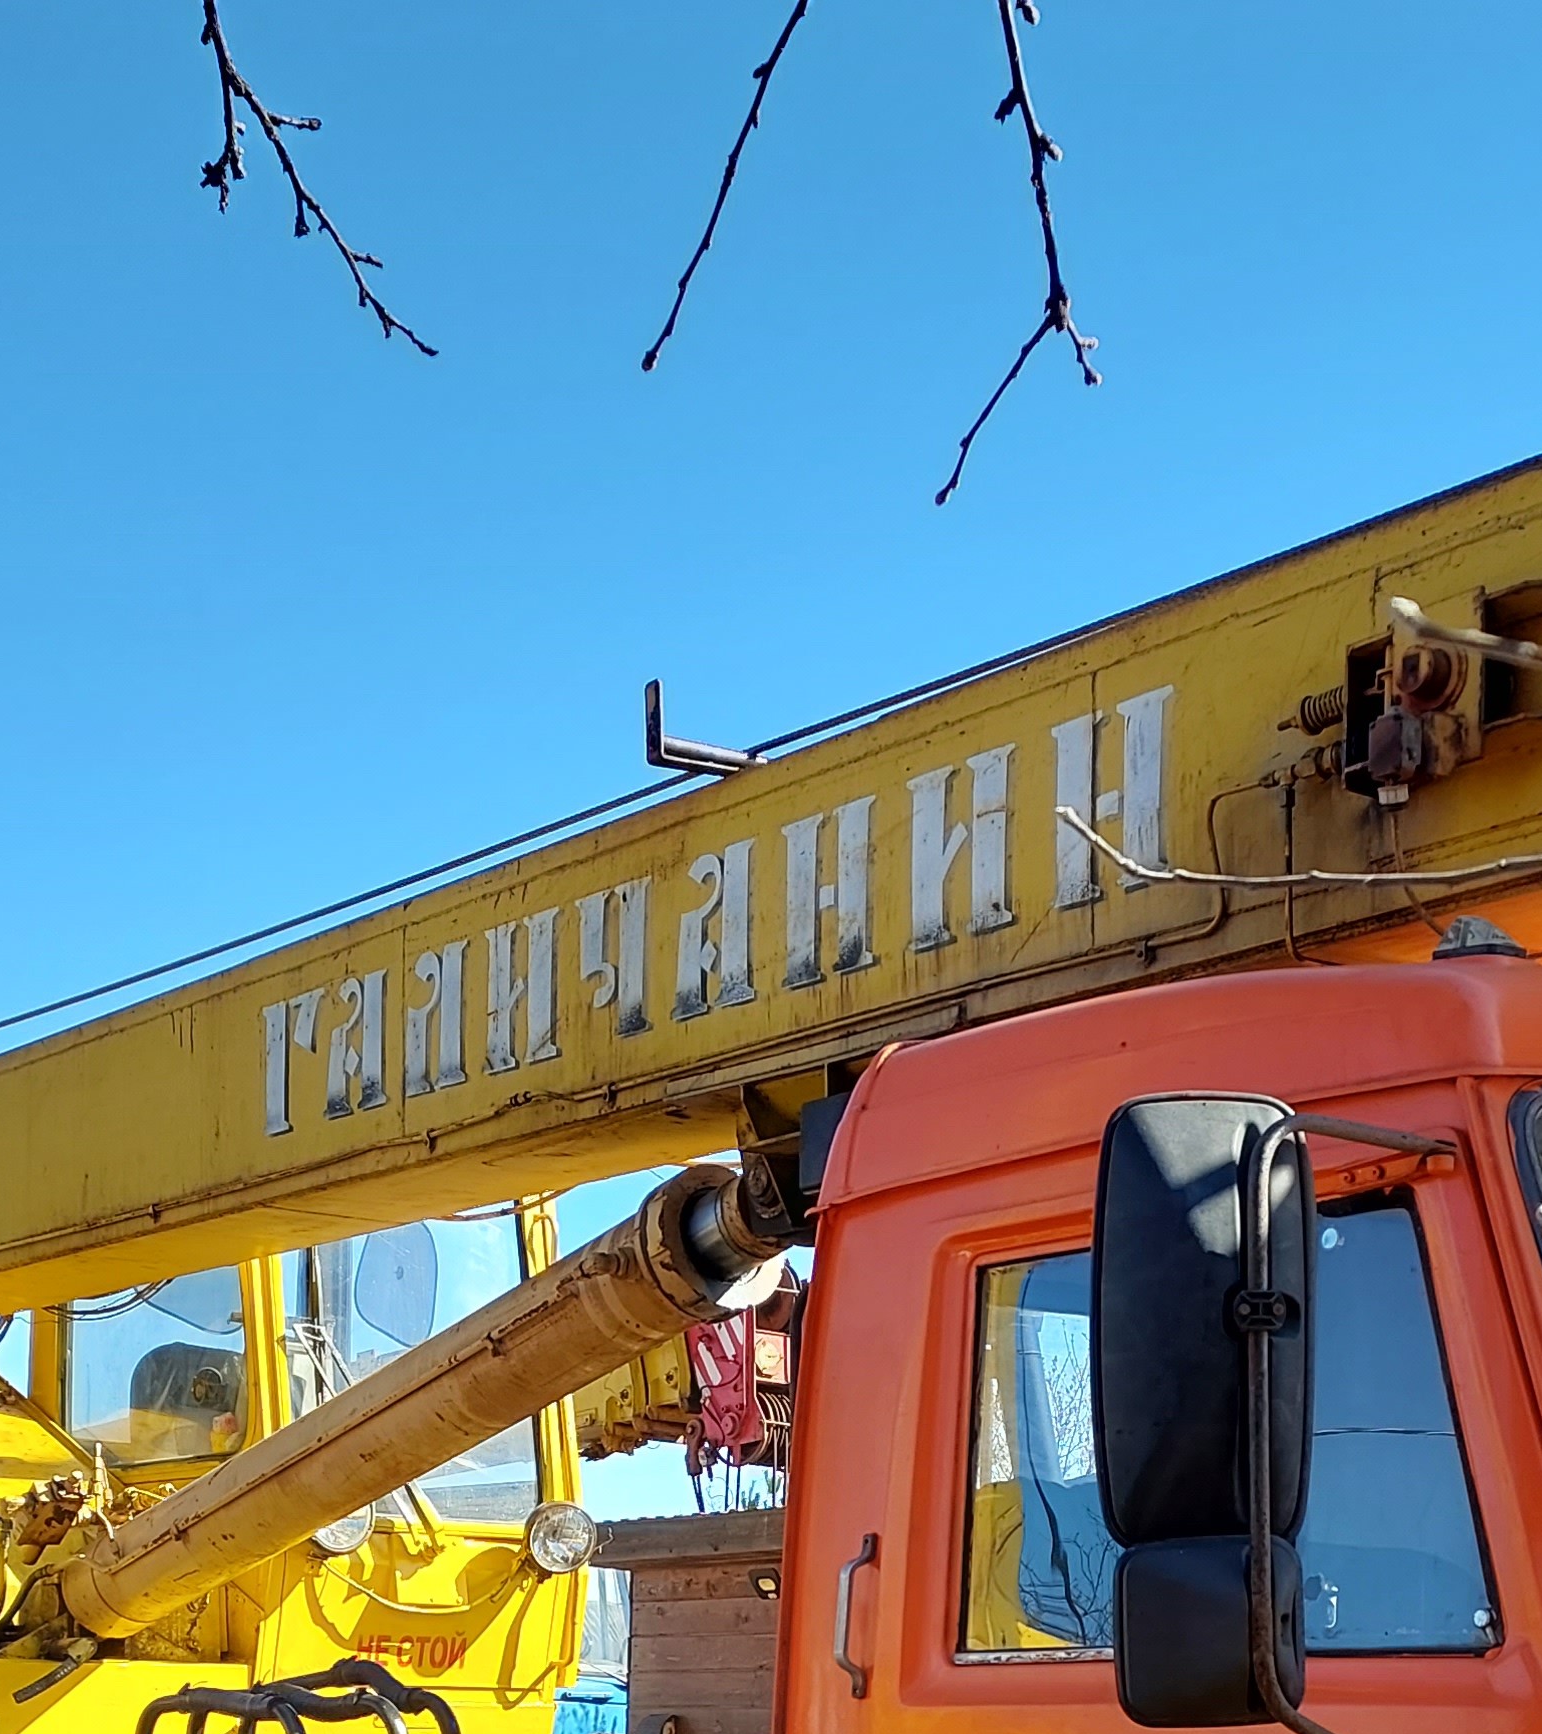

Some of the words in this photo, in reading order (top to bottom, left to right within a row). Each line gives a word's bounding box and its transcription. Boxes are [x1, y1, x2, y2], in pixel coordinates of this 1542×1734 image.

[259, 683, 1176, 1139] ГАЛИЧАНИН
[356, 1634, 392, 1667] НЕ
[396, 1631, 468, 1670] СТОЙ
